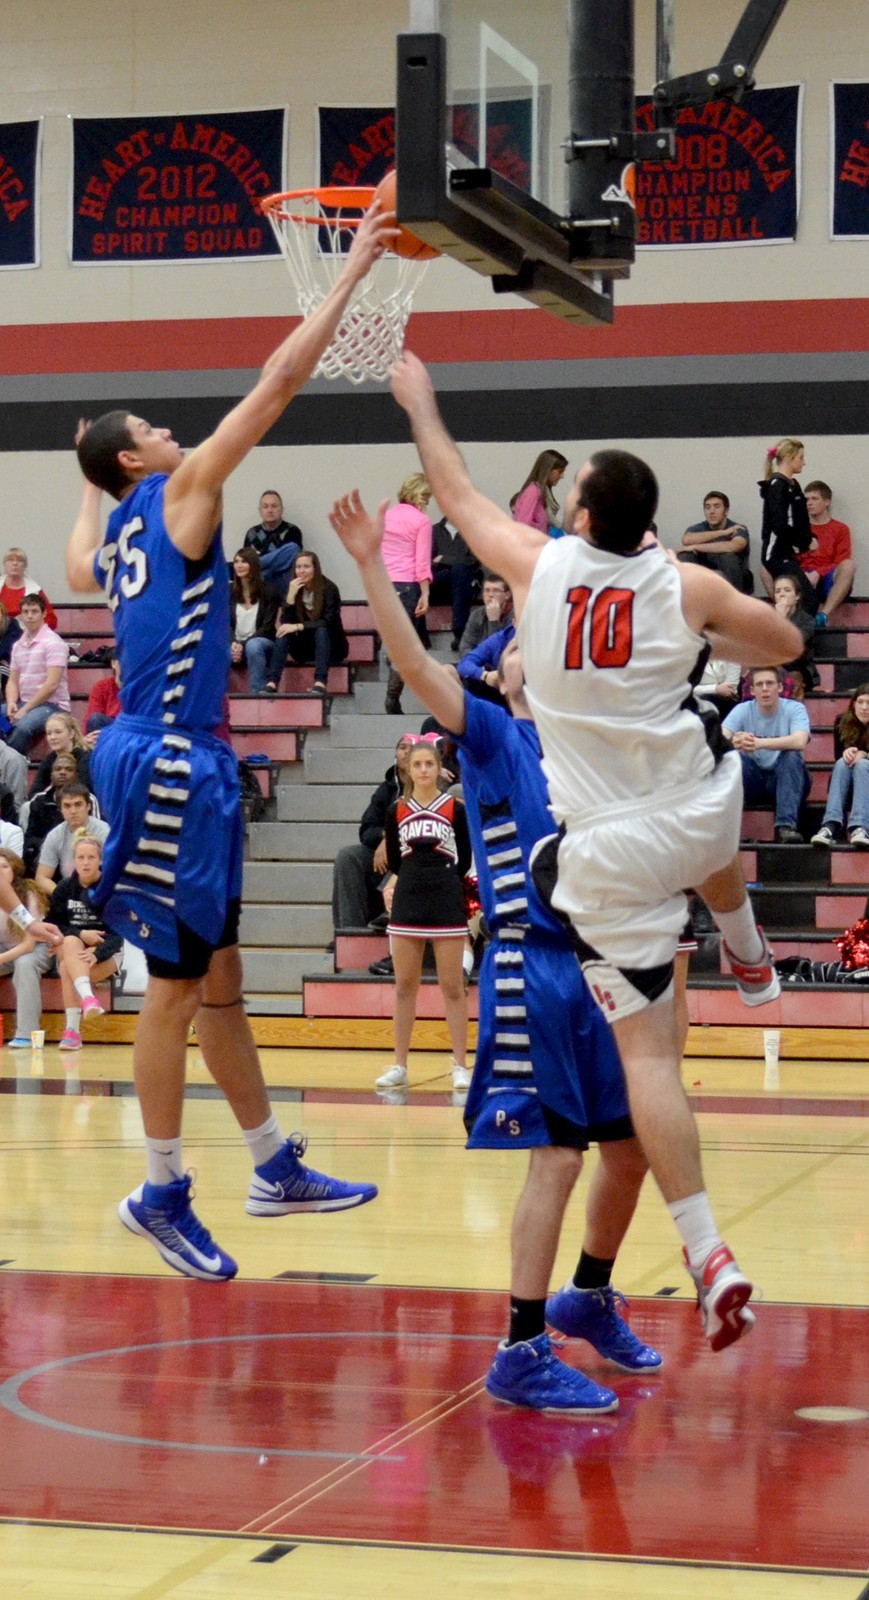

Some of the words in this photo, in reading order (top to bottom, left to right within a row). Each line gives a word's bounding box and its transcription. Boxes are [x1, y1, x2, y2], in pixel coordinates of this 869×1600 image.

[327, 113, 396, 187] EART
[642, 133, 728, 171] 008
[677, 101, 792, 192] AMERICA
[79, 129, 151, 220] HEART
[137, 163, 217, 199] 2012
[637, 169, 750, 195] HAMPION
[115, 203, 238, 228] CHAMPION
[638, 217, 763, 242] SKETBALL
[92, 231, 168, 254] SPIRIT
[184, 227, 262, 252] SQUAD
[98, 515, 147, 613] 25
[564, 585, 635, 669] 10
[400, 819, 449, 841] RAVENS
